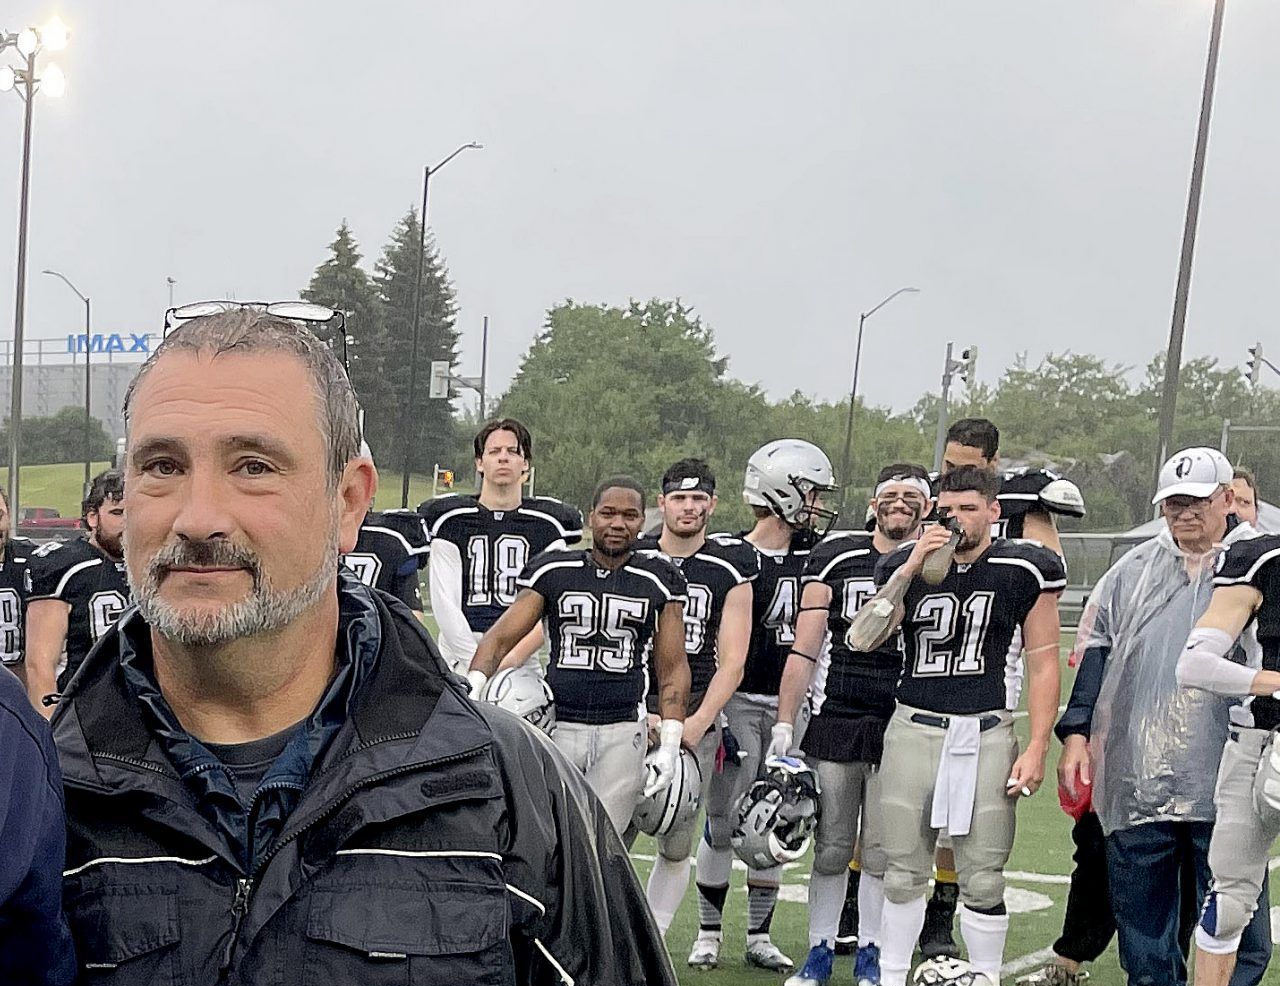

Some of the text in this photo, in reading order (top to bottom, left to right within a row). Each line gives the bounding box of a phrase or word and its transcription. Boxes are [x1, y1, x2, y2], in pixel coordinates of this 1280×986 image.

[67, 333, 150, 353] IMAX
[467, 534, 530, 607] 18
[557, 591, 650, 673] 25
[912, 591, 995, 677] 21
